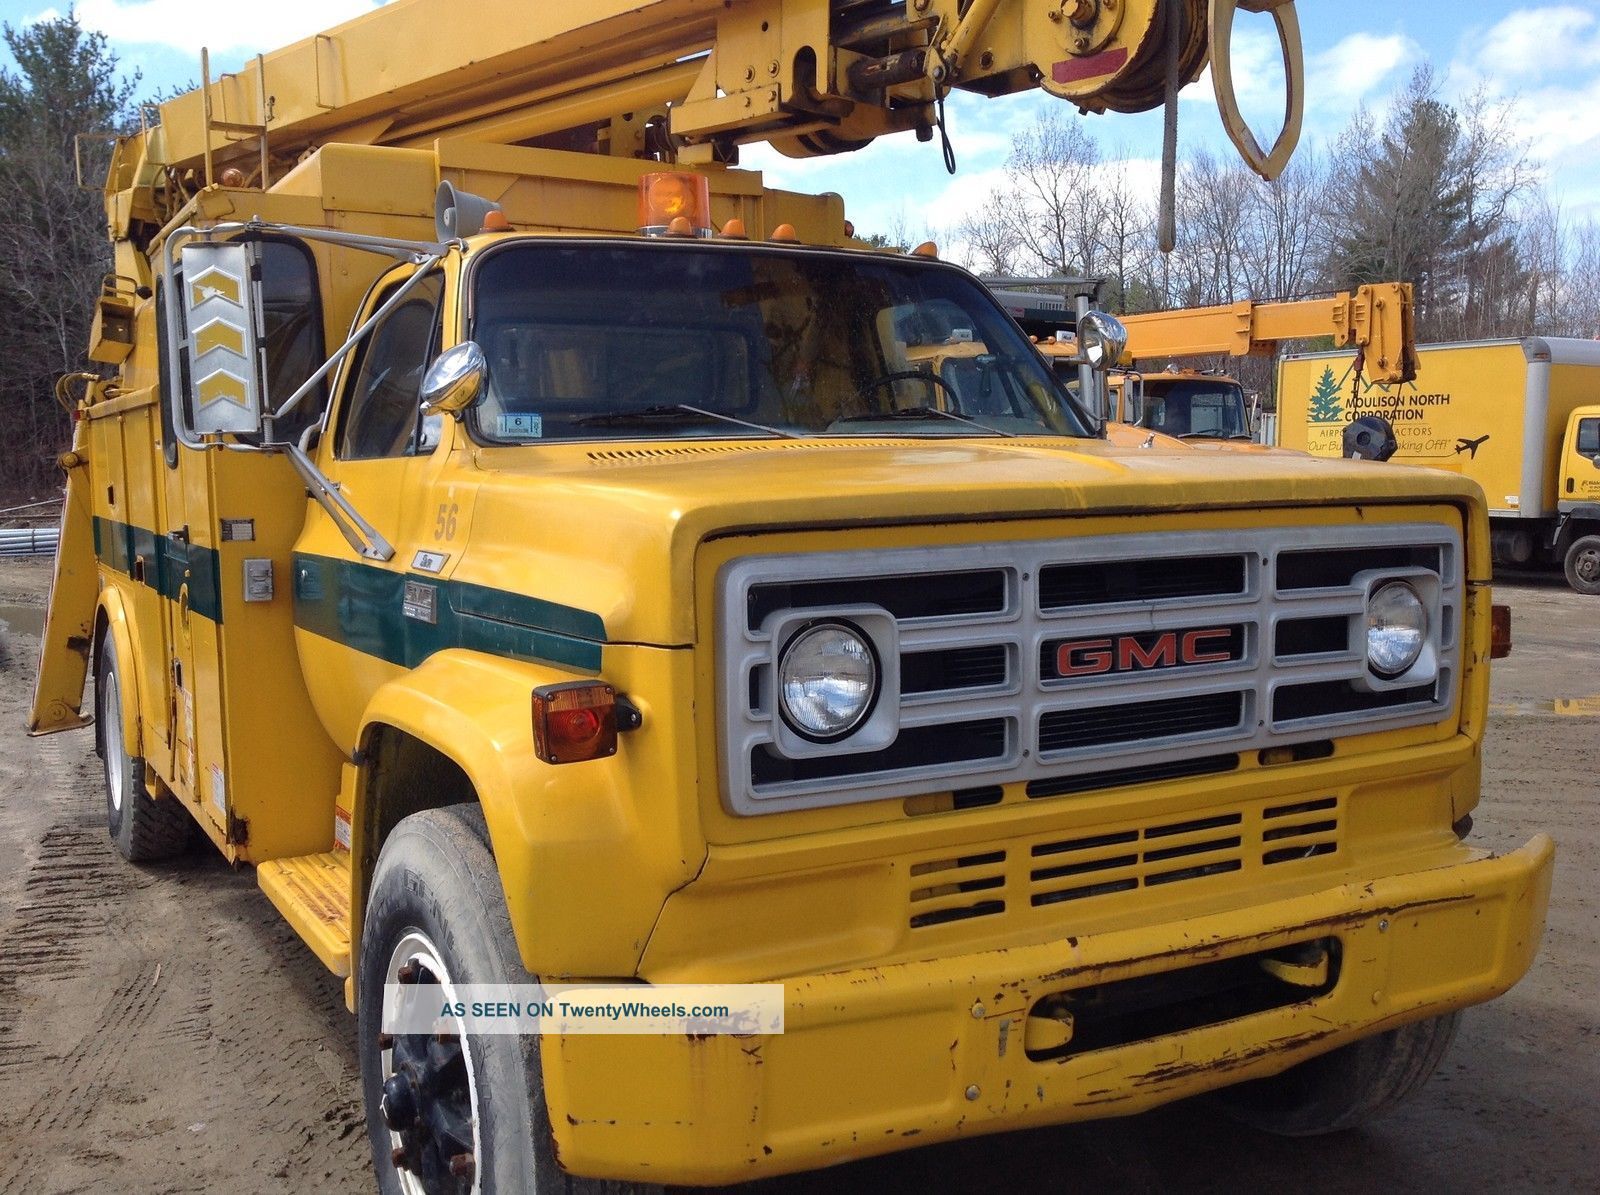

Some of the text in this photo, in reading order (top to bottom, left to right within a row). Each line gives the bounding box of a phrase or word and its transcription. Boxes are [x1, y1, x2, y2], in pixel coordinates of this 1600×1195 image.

[1345, 394, 1450, 409] MOULISON NORTH
[514, 417, 522, 426] 6
[1319, 429, 1344, 438] AIRPO
[434, 503, 459, 541] 56
[1056, 628, 1231, 677] GMC
